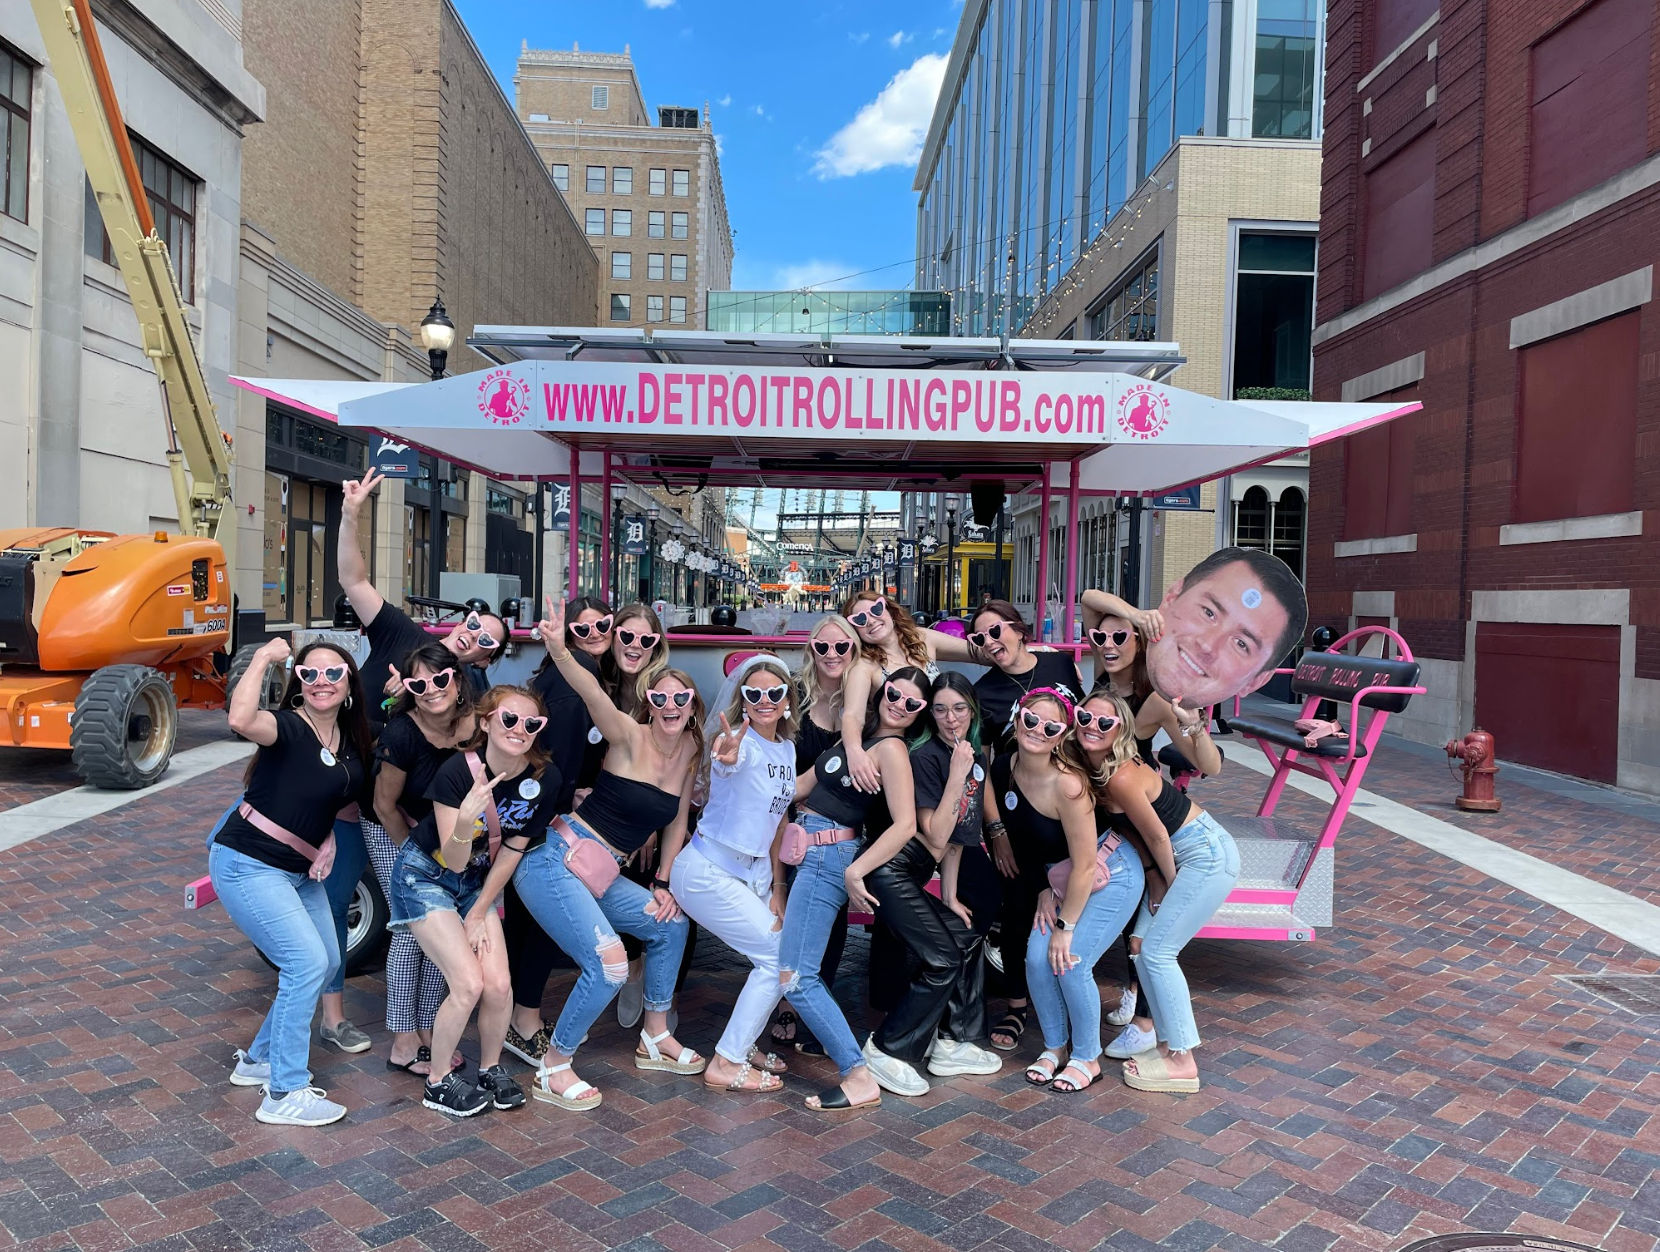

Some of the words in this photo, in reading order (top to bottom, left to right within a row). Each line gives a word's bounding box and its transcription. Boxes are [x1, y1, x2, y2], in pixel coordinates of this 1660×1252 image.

[478, 370, 512, 392] MADE
[519, 378, 530, 393] IN
[543, 372, 1105, 434] www.DETROITROLLINGPUB.com
[1118, 384, 1153, 406] MADE
[1159, 392, 1170, 407] IN
[478, 403, 530, 426] DETROIT
[1117, 417, 1169, 440] DETROIT
[1297, 664, 1326, 683] DETROIT
[1329, 667, 1362, 688] ROLLING
